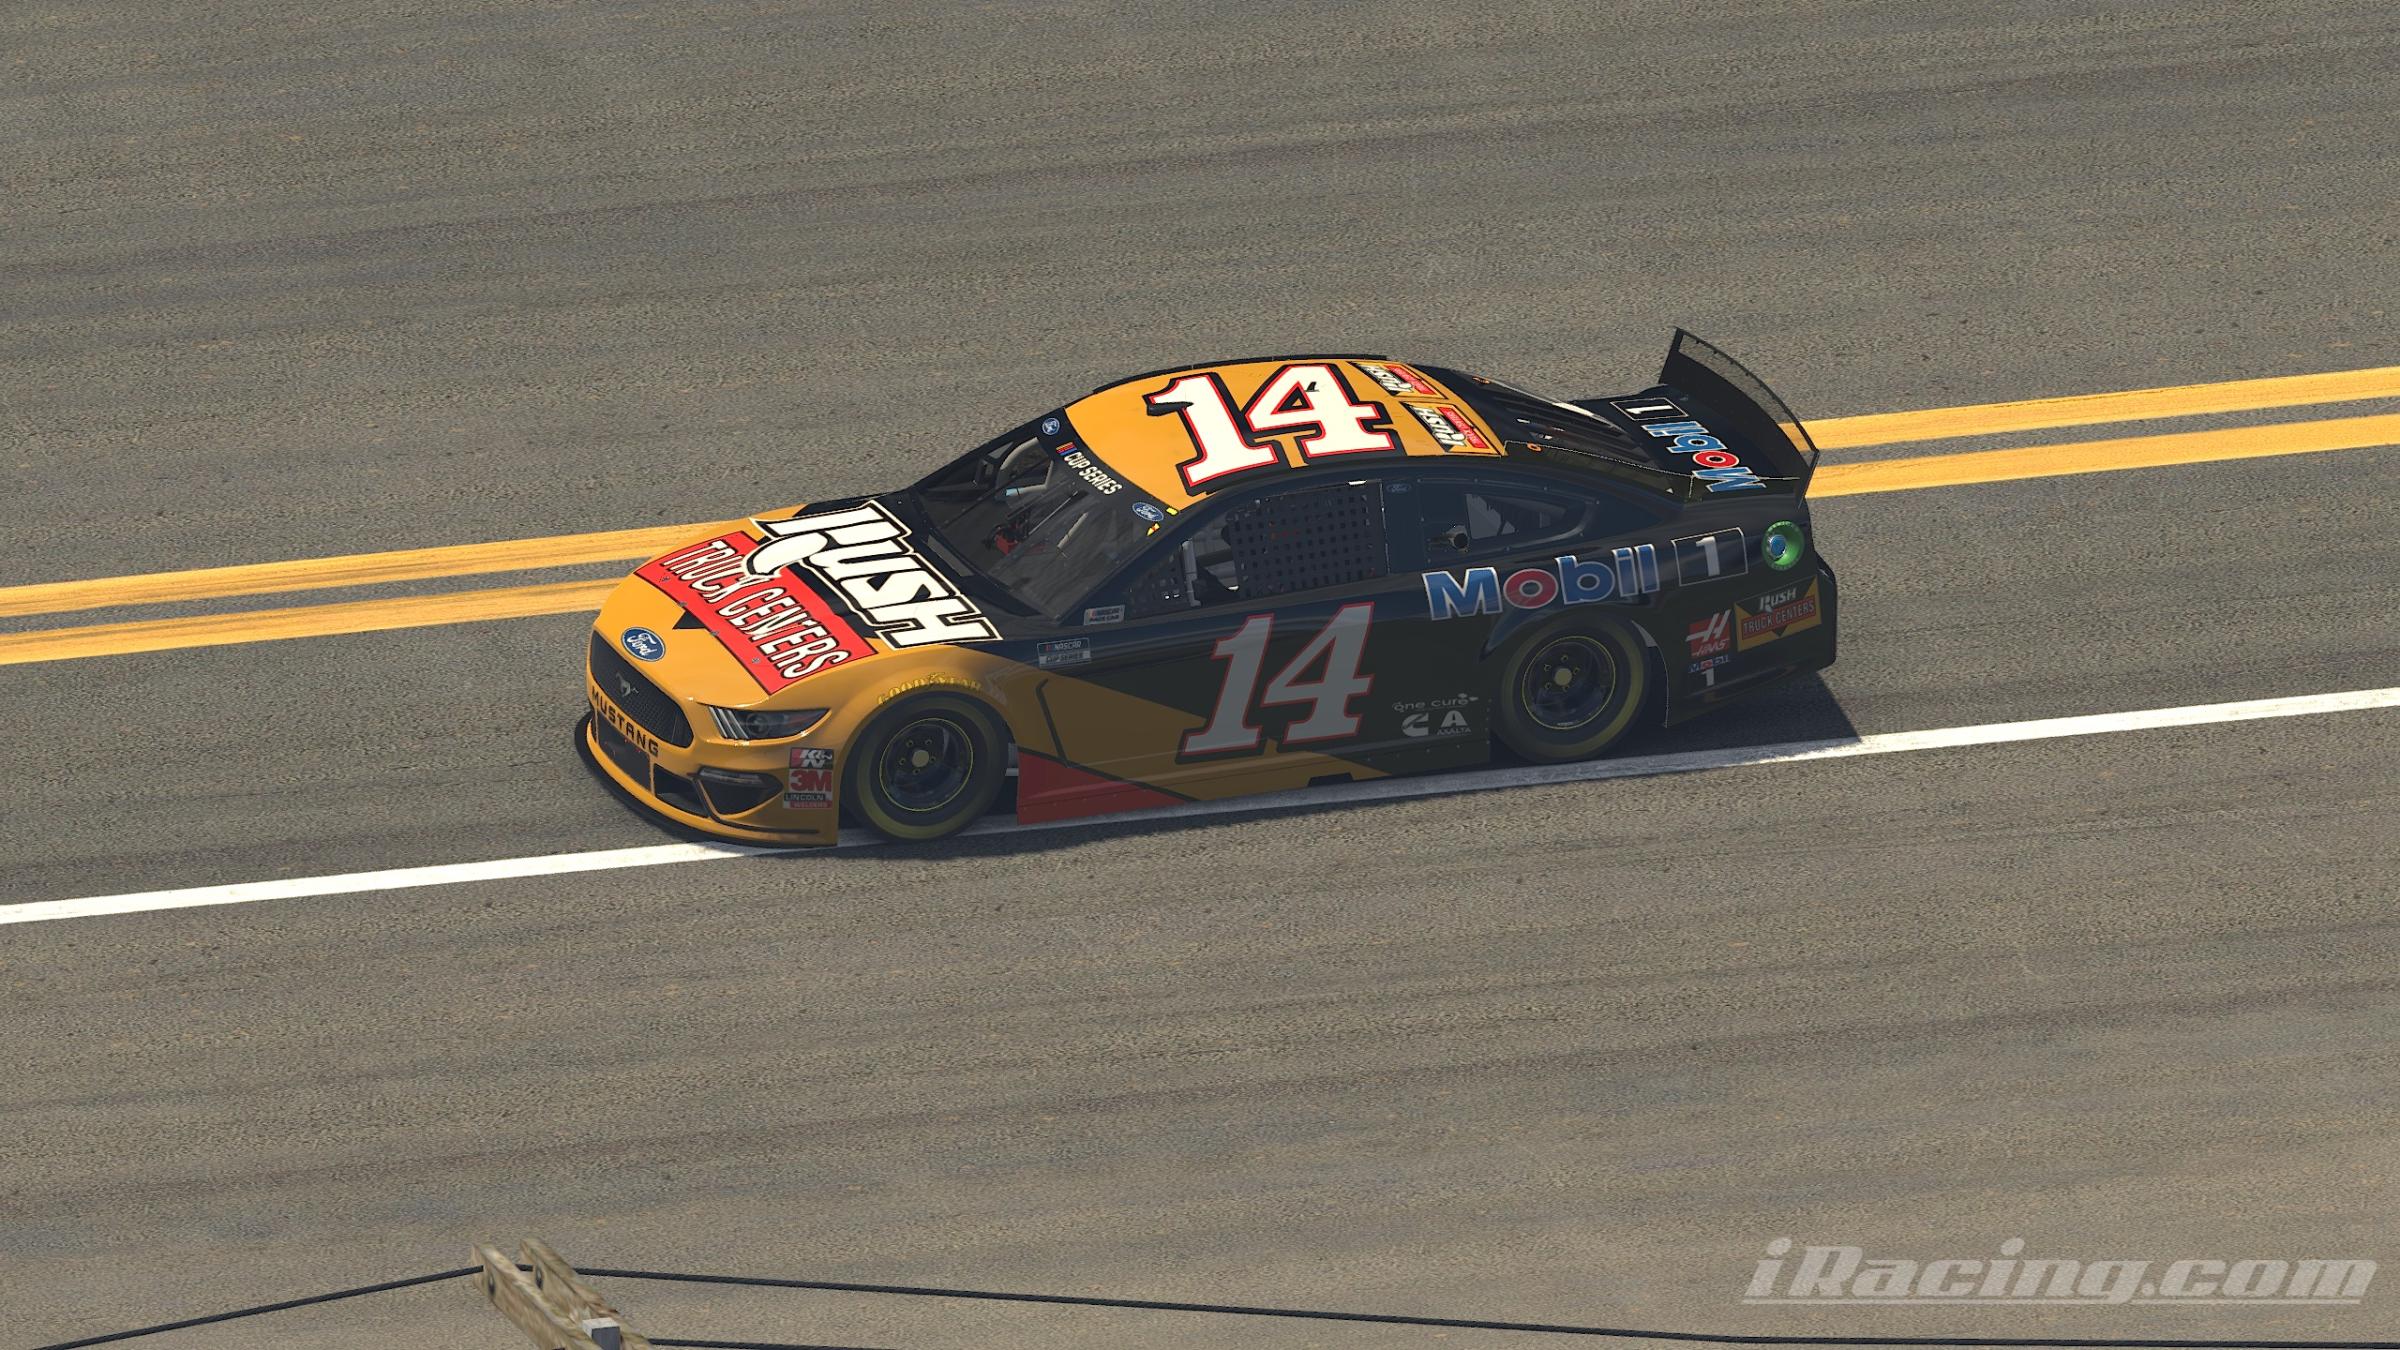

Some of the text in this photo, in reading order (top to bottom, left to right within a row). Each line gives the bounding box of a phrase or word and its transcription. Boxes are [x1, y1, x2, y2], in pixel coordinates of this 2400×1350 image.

[1148, 363, 1396, 490] 14
[1641, 420, 1768, 493] Mobil
[1063, 451, 1123, 495] CUP SERIES
[662, 540, 853, 680] TRUCK CENTERS
[742, 501, 1002, 651] RUSH
[1421, 535, 1721, 621] Mobil 1
[1759, 587, 1798, 613] RUSH
[626, 632, 659, 657] Ford
[1743, 600, 1816, 634] TRUCK CENTERS
[1182, 601, 1375, 755] 14
[590, 685, 660, 757] MUSTANG
[790, 769, 833, 792] 3M
